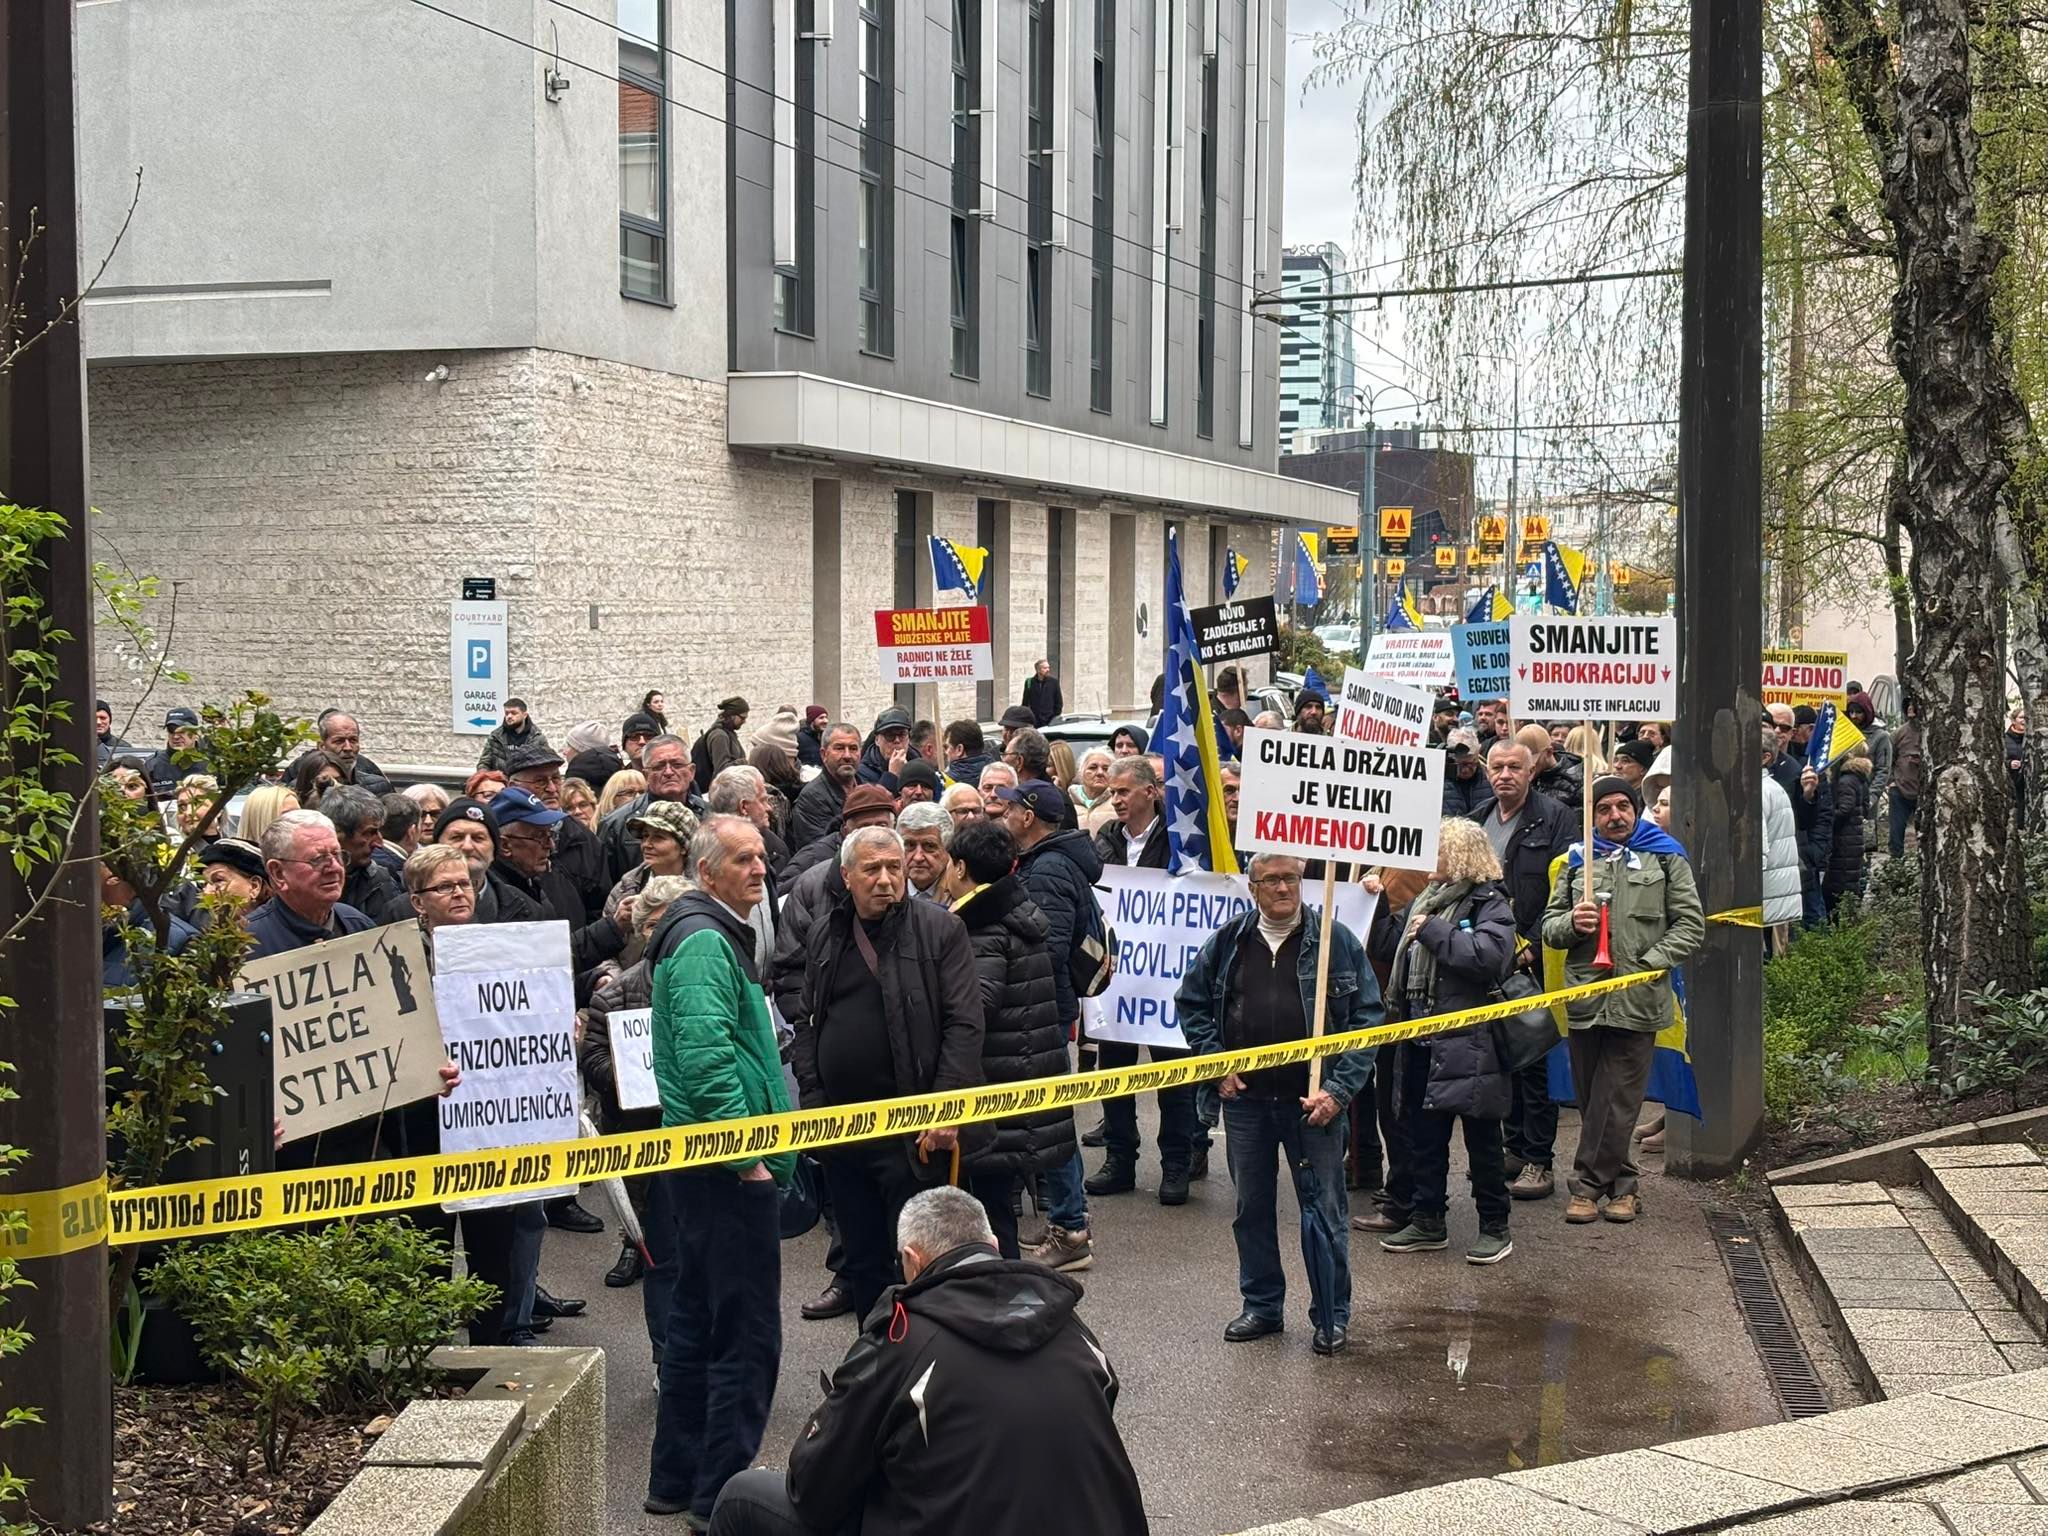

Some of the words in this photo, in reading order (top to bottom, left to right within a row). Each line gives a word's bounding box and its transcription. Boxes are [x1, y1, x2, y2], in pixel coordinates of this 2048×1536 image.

[454, 613, 503, 622] COURTYARD
[892, 610, 971, 632] SMANJITE
[1219, 605, 1245, 621] NOVO
[894, 633, 942, 645] BUDŽETSKE
[944, 631, 971, 643] PLATE
[1203, 619, 1258, 640] ZADUŽENJE
[1259, 617, 1266, 630] ?
[1466, 628, 1510, 647] SUBVEN
[1529, 624, 1659, 655] SMANJITE
[897, 651, 933, 663] RADNICI
[936, 650, 948, 662] NE
[950, 648, 972, 661] ŽELE
[1201, 646, 1213, 659] KO
[1214, 641, 1227, 656] ĆE
[1228, 635, 1265, 653] VRAĆATI
[1267, 634, 1273, 646] ?
[1386, 639, 1419, 649] VRATITE
[1421, 639, 1443, 649] NAM
[472, 646, 488, 673] P
[898, 666, 911, 678] DA
[913, 664, 932, 677] ŽIVE
[934, 665, 948, 676] NA
[951, 664, 973, 676] RATE
[1471, 654, 1488, 670] NE
[1762, 653, 1784, 663] DNICI
[1793, 653, 1843, 665] POSLODAVCI
[1468, 676, 1510, 693] EGZISTE
[1532, 662, 1656, 684] BIROKRACIJU
[1762, 665, 1842, 689] AJEDNO
[464, 690, 497, 700] GARAGE
[464, 701, 497, 712] GARAŽA
[1346, 683, 1370, 706] SAMO
[1371, 694, 1382, 710] SU
[1385, 697, 1401, 717] KOD
[1403, 703, 1424, 724] NAS
[1528, 698, 1580, 712] SMANJILI
[1583, 699, 1601, 712] STE
[1605, 699, 1660, 713] INFLACIJU
[1340, 708, 1420, 747] KLADIONICE
[1260, 739, 1336, 771] CIJELA
[1343, 747, 1428, 781] DRŽAVA
[1292, 780, 1319, 806] JE
[1326, 783, 1392, 814] VELIKI
[1255, 810, 1423, 857] KAMENOLOM
[1117, 888, 1166, 925] NOVA
[478, 980, 530, 1013] NOVA
[1117, 995, 1179, 1029] NPU
[279, 1001, 370, 1058] NEĆE
[623, 1017, 650, 1039] NOV
[444, 1032, 573, 1071] ENZIONERSKA
[279, 1046, 398, 1116] STATI
[1051, 1080, 1095, 1103] POLICIJA
[1094, 1077, 1120, 1097] STOP
[442, 1086, 574, 1130] UMIROVLJENIČKA
[936, 1099, 965, 1124] STOP
[972, 1091, 1019, 1116] POLICIJA
[1018, 1087, 1046, 1110] STOP
[847, 1111, 877, 1137] STOP
[886, 1103, 934, 1130] POLICIJA
[748, 1124, 779, 1153] STOP
[790, 1117, 844, 1145] POLICIJA
[634, 1138, 671, 1170] STOP
[684, 1129, 744, 1161] POLICIJA
[510, 1154, 551, 1186] STOP
[566, 1144, 631, 1178] POLICIJA
[371, 1169, 416, 1204] STOP
[432, 1159, 508, 1196] POLICIJA
[213, 1186, 263, 1223] STOP
[283, 1176, 365, 1215] POLICIJA
[111, 1192, 204, 1234] POLICIJA
